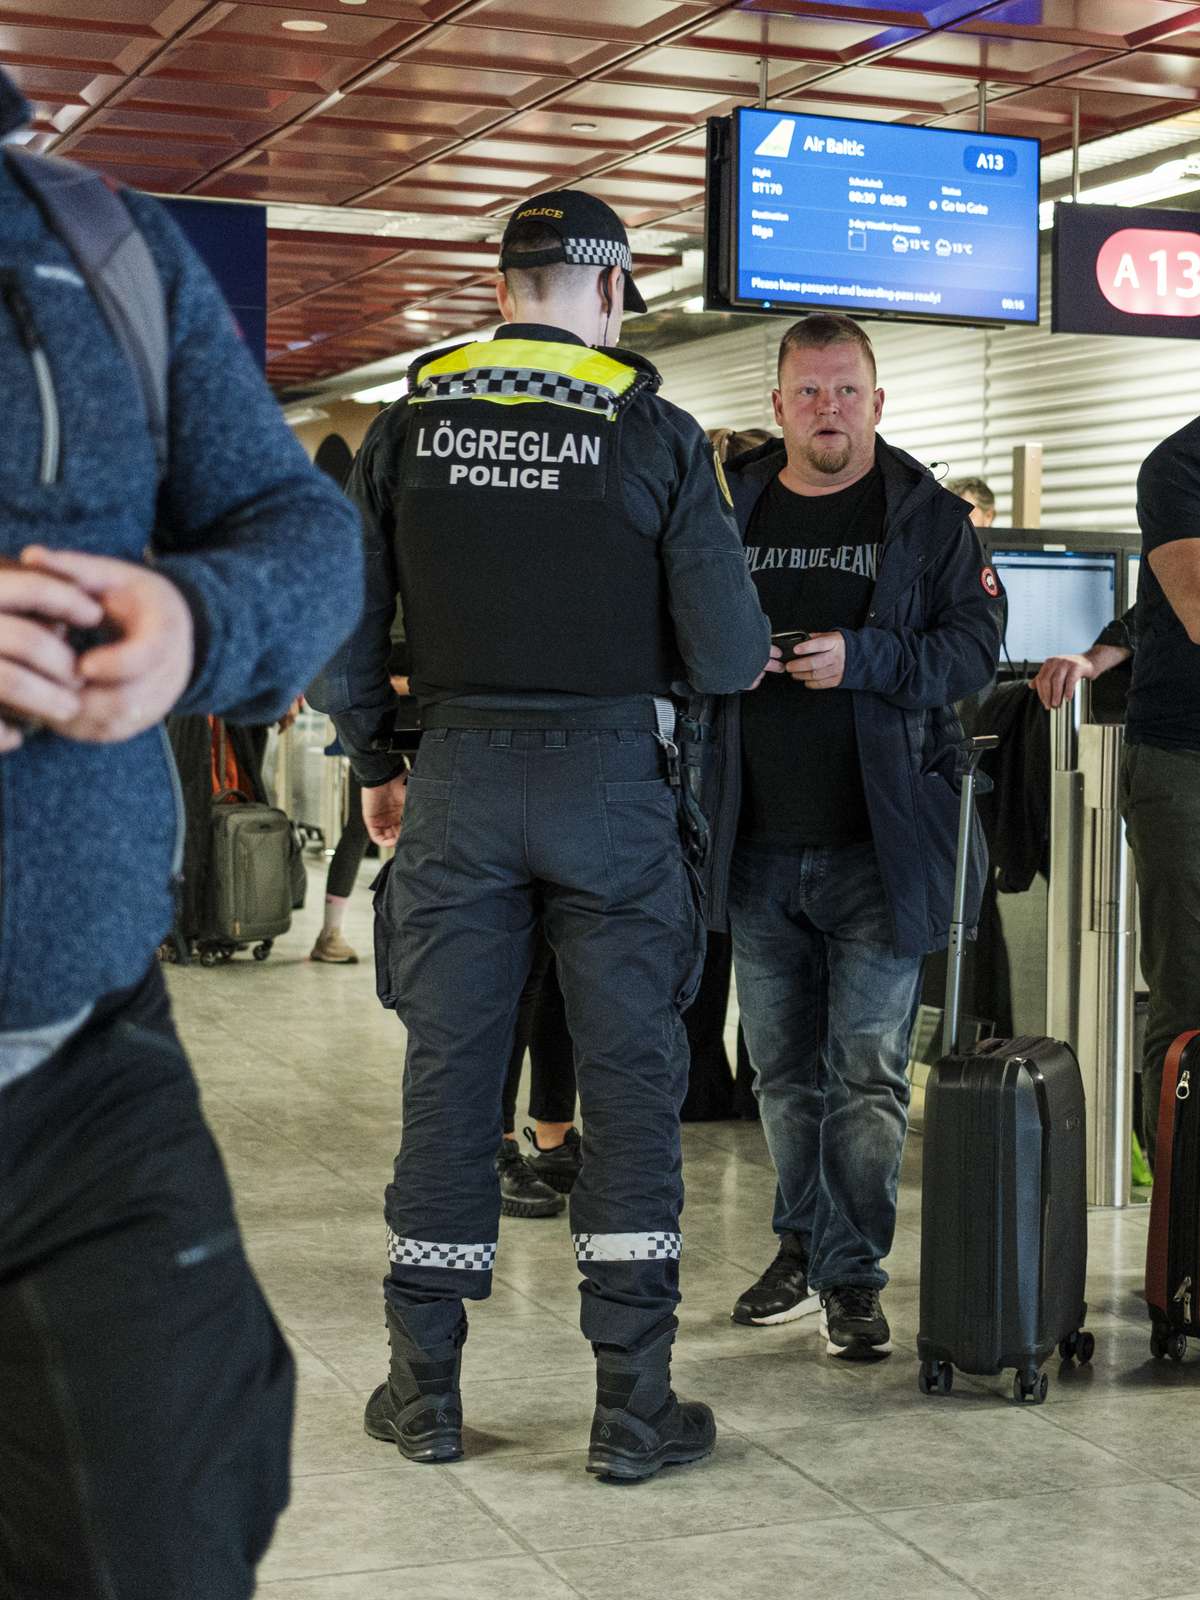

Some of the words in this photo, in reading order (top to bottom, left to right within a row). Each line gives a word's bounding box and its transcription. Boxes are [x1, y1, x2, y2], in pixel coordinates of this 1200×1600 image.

[803, 135, 825, 152] Air
[826, 139, 865, 157] Baltic
[976, 153, 1004, 171] A13
[752, 182, 783, 196] BT170
[516, 207, 564, 220] POLICE
[941, 200, 955, 212] Go
[955, 202, 966, 213] to
[966, 202, 989, 216] Gate
[752, 224, 774, 240] Riga
[751, 277, 779, 291] Please
[779, 279, 800, 292] have
[800, 283, 838, 296] passport
[838, 285, 855, 297] and
[416, 420, 601, 466] LÖGREGLAN
[450, 465, 561, 490] POLICE
[789, 547, 831, 570] BLUE
